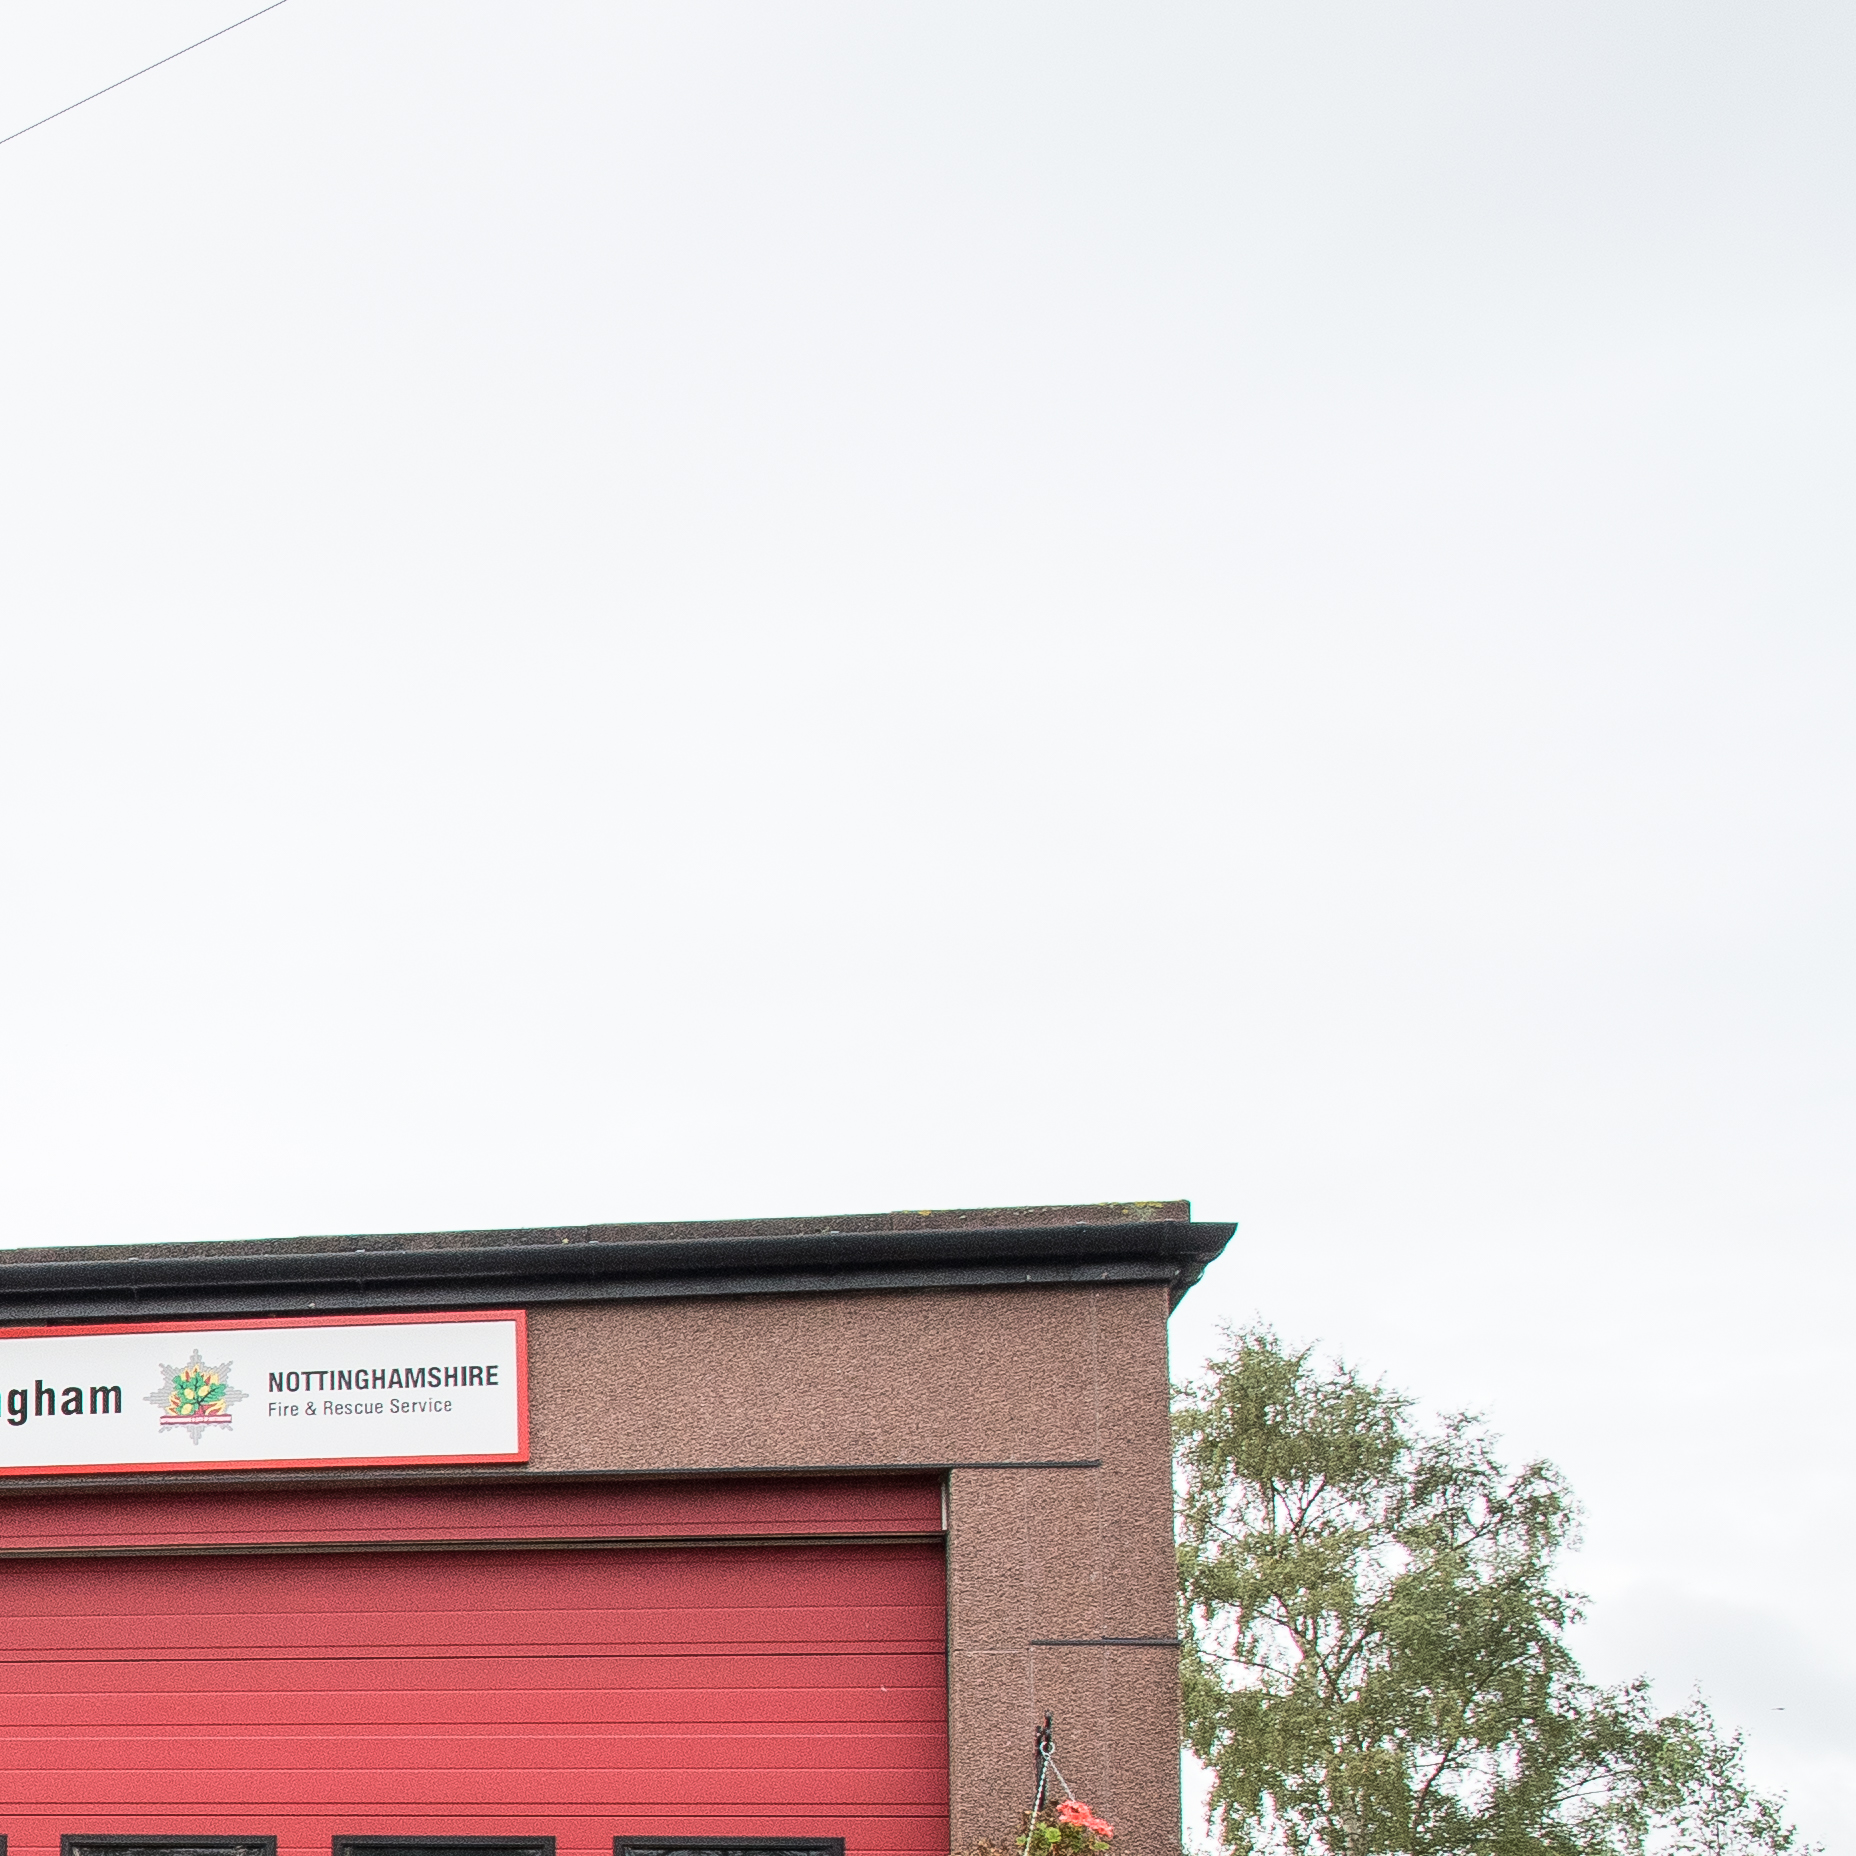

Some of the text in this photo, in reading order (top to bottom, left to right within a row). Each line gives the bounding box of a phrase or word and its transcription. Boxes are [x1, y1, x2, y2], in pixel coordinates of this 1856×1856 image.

[268, 1365, 499, 1393] NOTTINGHAMSHIRE
[268, 1397, 453, 1417] Fire & Rescue Service
